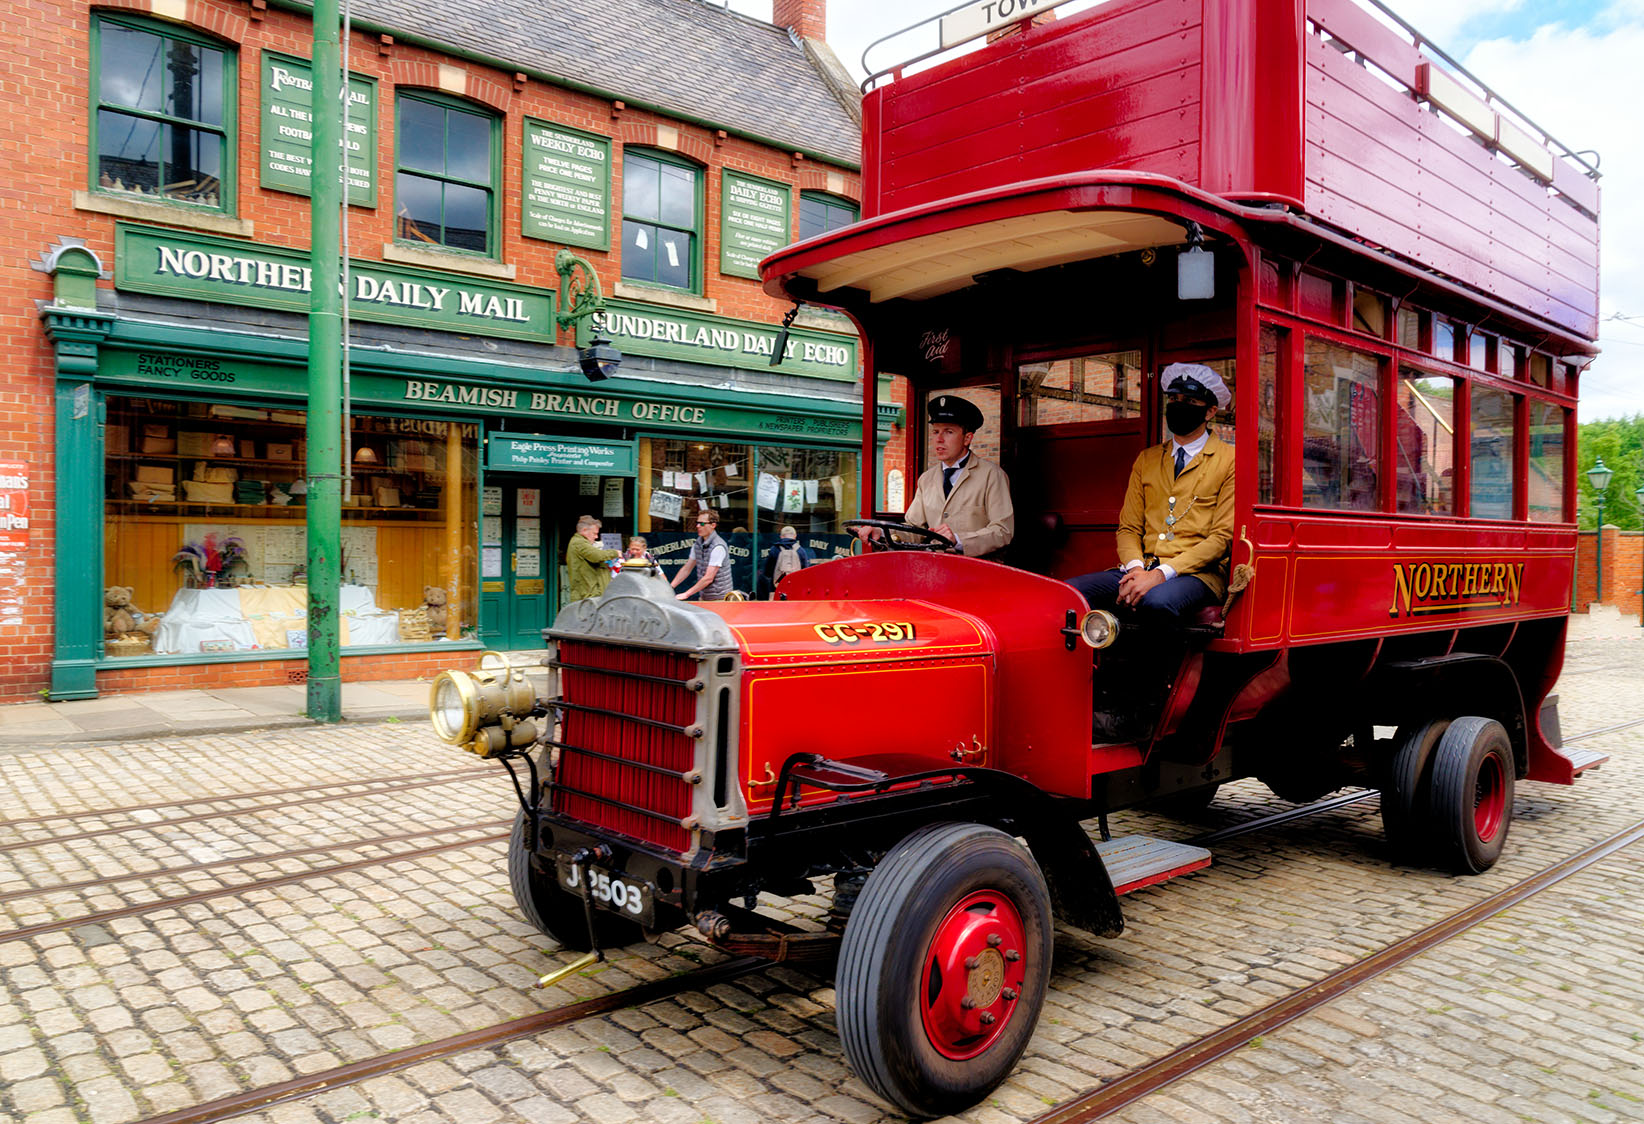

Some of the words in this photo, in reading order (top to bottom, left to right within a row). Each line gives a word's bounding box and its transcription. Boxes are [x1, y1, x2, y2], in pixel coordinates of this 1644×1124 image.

[271, 67, 312, 91] FOOTB
[270, 105, 288, 117] ALL
[289, 109, 307, 121] THE
[279, 125, 312, 140] FOOTB
[344, 122, 367, 134] EWS
[531, 134, 575, 153] WEEKLY
[577, 146, 604, 160] ECHO
[555, 134, 594, 147] SUNDERLAND
[268, 150, 285, 160] THE
[286, 154, 304, 164] BEST
[543, 157, 569, 168] TWELVE
[571, 163, 592, 173] PAGES
[269, 162, 295, 173] CODES
[295, 167, 312, 176] HAV
[539, 164, 557, 173] PRICE
[574, 173, 595, 182] PENNY
[534, 188, 554, 197] PENNY
[556, 193, 580, 202] WEEKLY
[730, 185, 757, 199] DAILY
[759, 193, 782, 205] ECHO
[577, 204, 604, 214] ENGLAND
[158, 246, 344, 297] NORTHE
[356, 275, 451, 310] DAILY
[458, 290, 531, 321] MAIL
[592, 312, 738, 350] SUNDERLAND
[743, 333, 798, 359] DAIY
[803, 343, 849, 365] ECHO
[919, 328, 949, 349] First
[138, 353, 220, 370] STATIONERS
[138, 365, 182, 377] FANCY
[191, 369, 236, 382] GOODS
[405, 380, 517, 408] BEAMISH
[530, 392, 619, 417] BRANCH
[632, 402, 705, 424] OFFICE
[766, 422, 804, 432] NEWSPAPER
[807, 426, 849, 436] PROPRIETORS
[511, 441, 532, 453] Eagle
[533, 443, 556, 453] Press
[557, 444, 589, 456] Printing
[589, 446, 614, 456] Works
[728, 545, 750, 558] ECHO
[810, 540, 829, 551] DAILY
[1389, 562, 1524, 616] NORTHERN
[814, 622, 915, 646] CC-297
[588, 869, 643, 914] 2503
